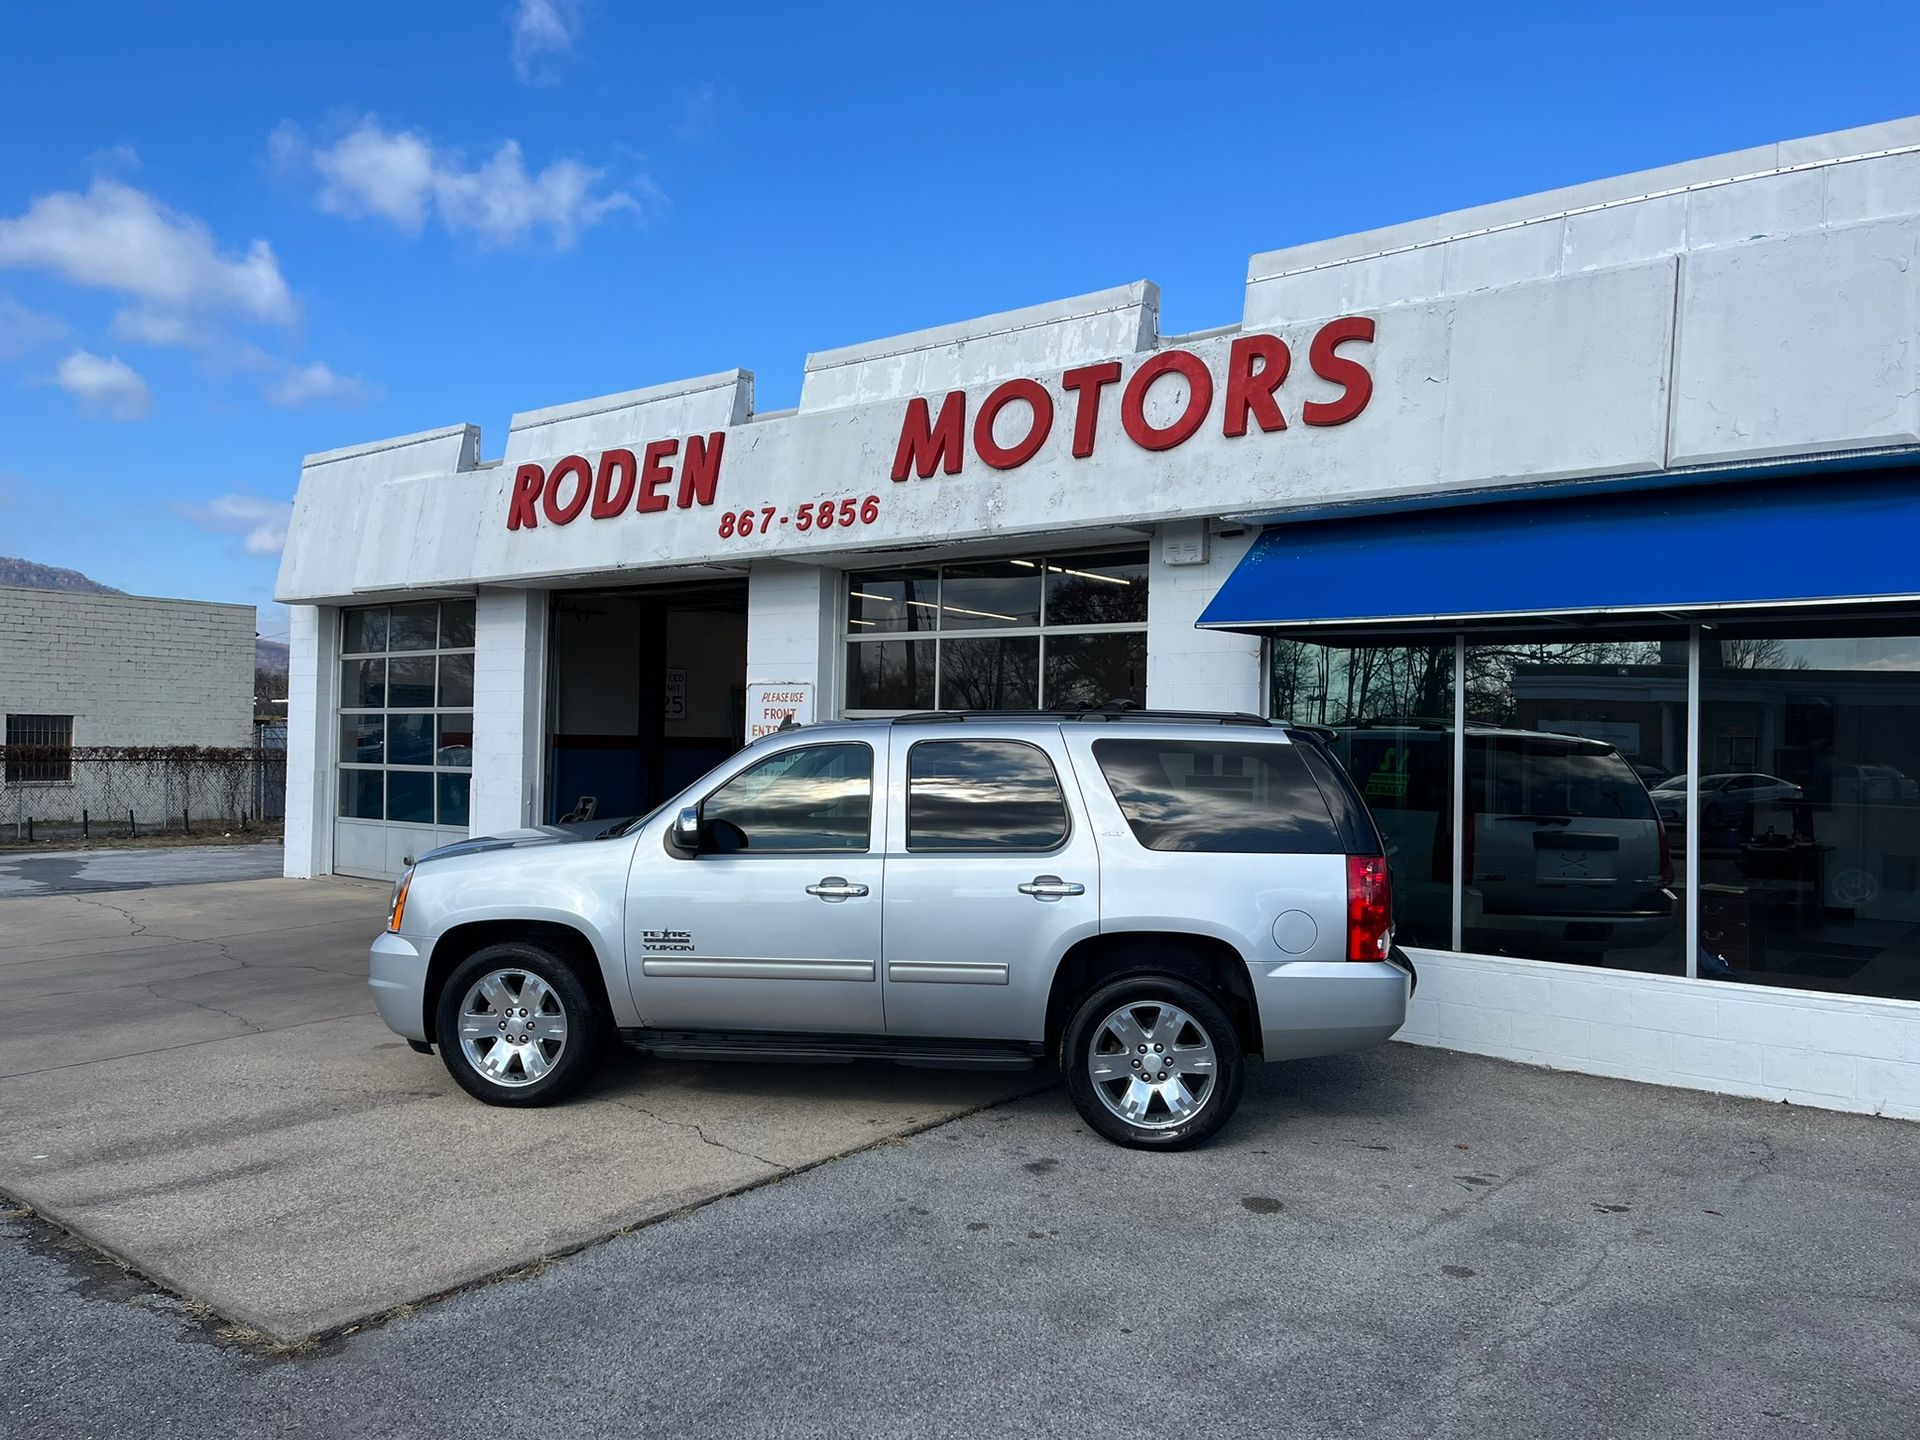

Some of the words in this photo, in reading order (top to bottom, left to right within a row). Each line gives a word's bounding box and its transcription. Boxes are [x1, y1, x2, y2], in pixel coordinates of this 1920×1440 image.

[507, 431, 726, 531] RODEN
[891, 316, 1375, 482] MOTORS
[718, 494, 880, 539] 867-5856
[664, 673, 684, 682] EED
[761, 692, 789, 703] PLEASE
[790, 692, 804, 703] USE
[764, 708, 797, 720] FRONT
